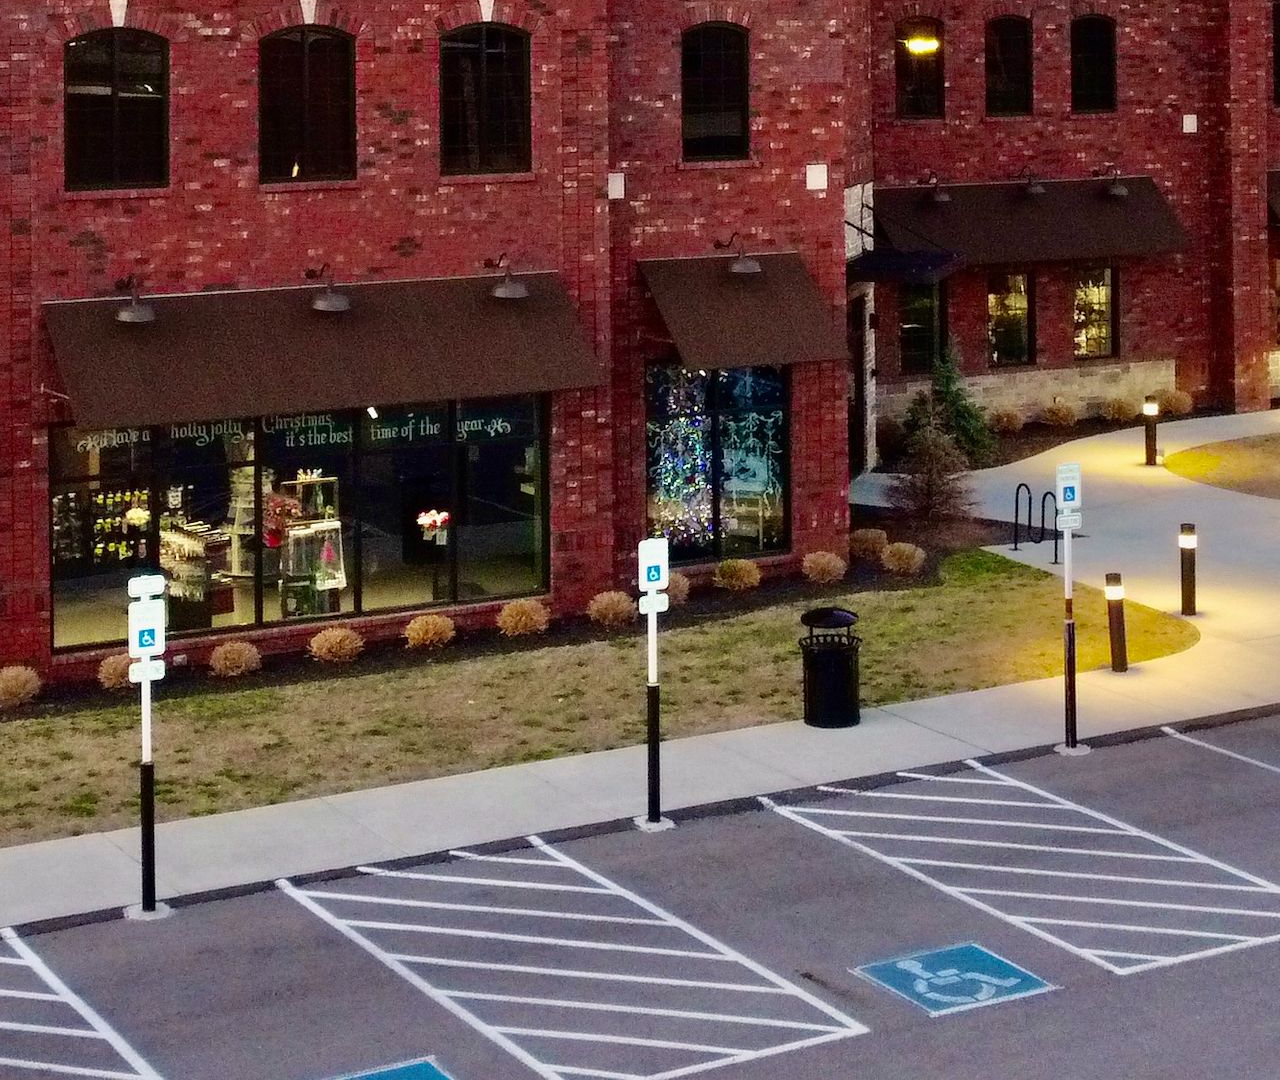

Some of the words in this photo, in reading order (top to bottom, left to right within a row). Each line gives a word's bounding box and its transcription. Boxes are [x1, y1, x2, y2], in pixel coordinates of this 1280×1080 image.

[142, 430, 151, 442] a
[170, 422, 209, 447] holly
[210, 419, 245, 444] jolly
[286, 427, 306, 447] it's
[308, 425, 327, 446] the
[329, 423, 354, 444] best
[370, 424, 400, 441] time
[401, 419, 416, 442] of
[419, 416, 441, 436] the
